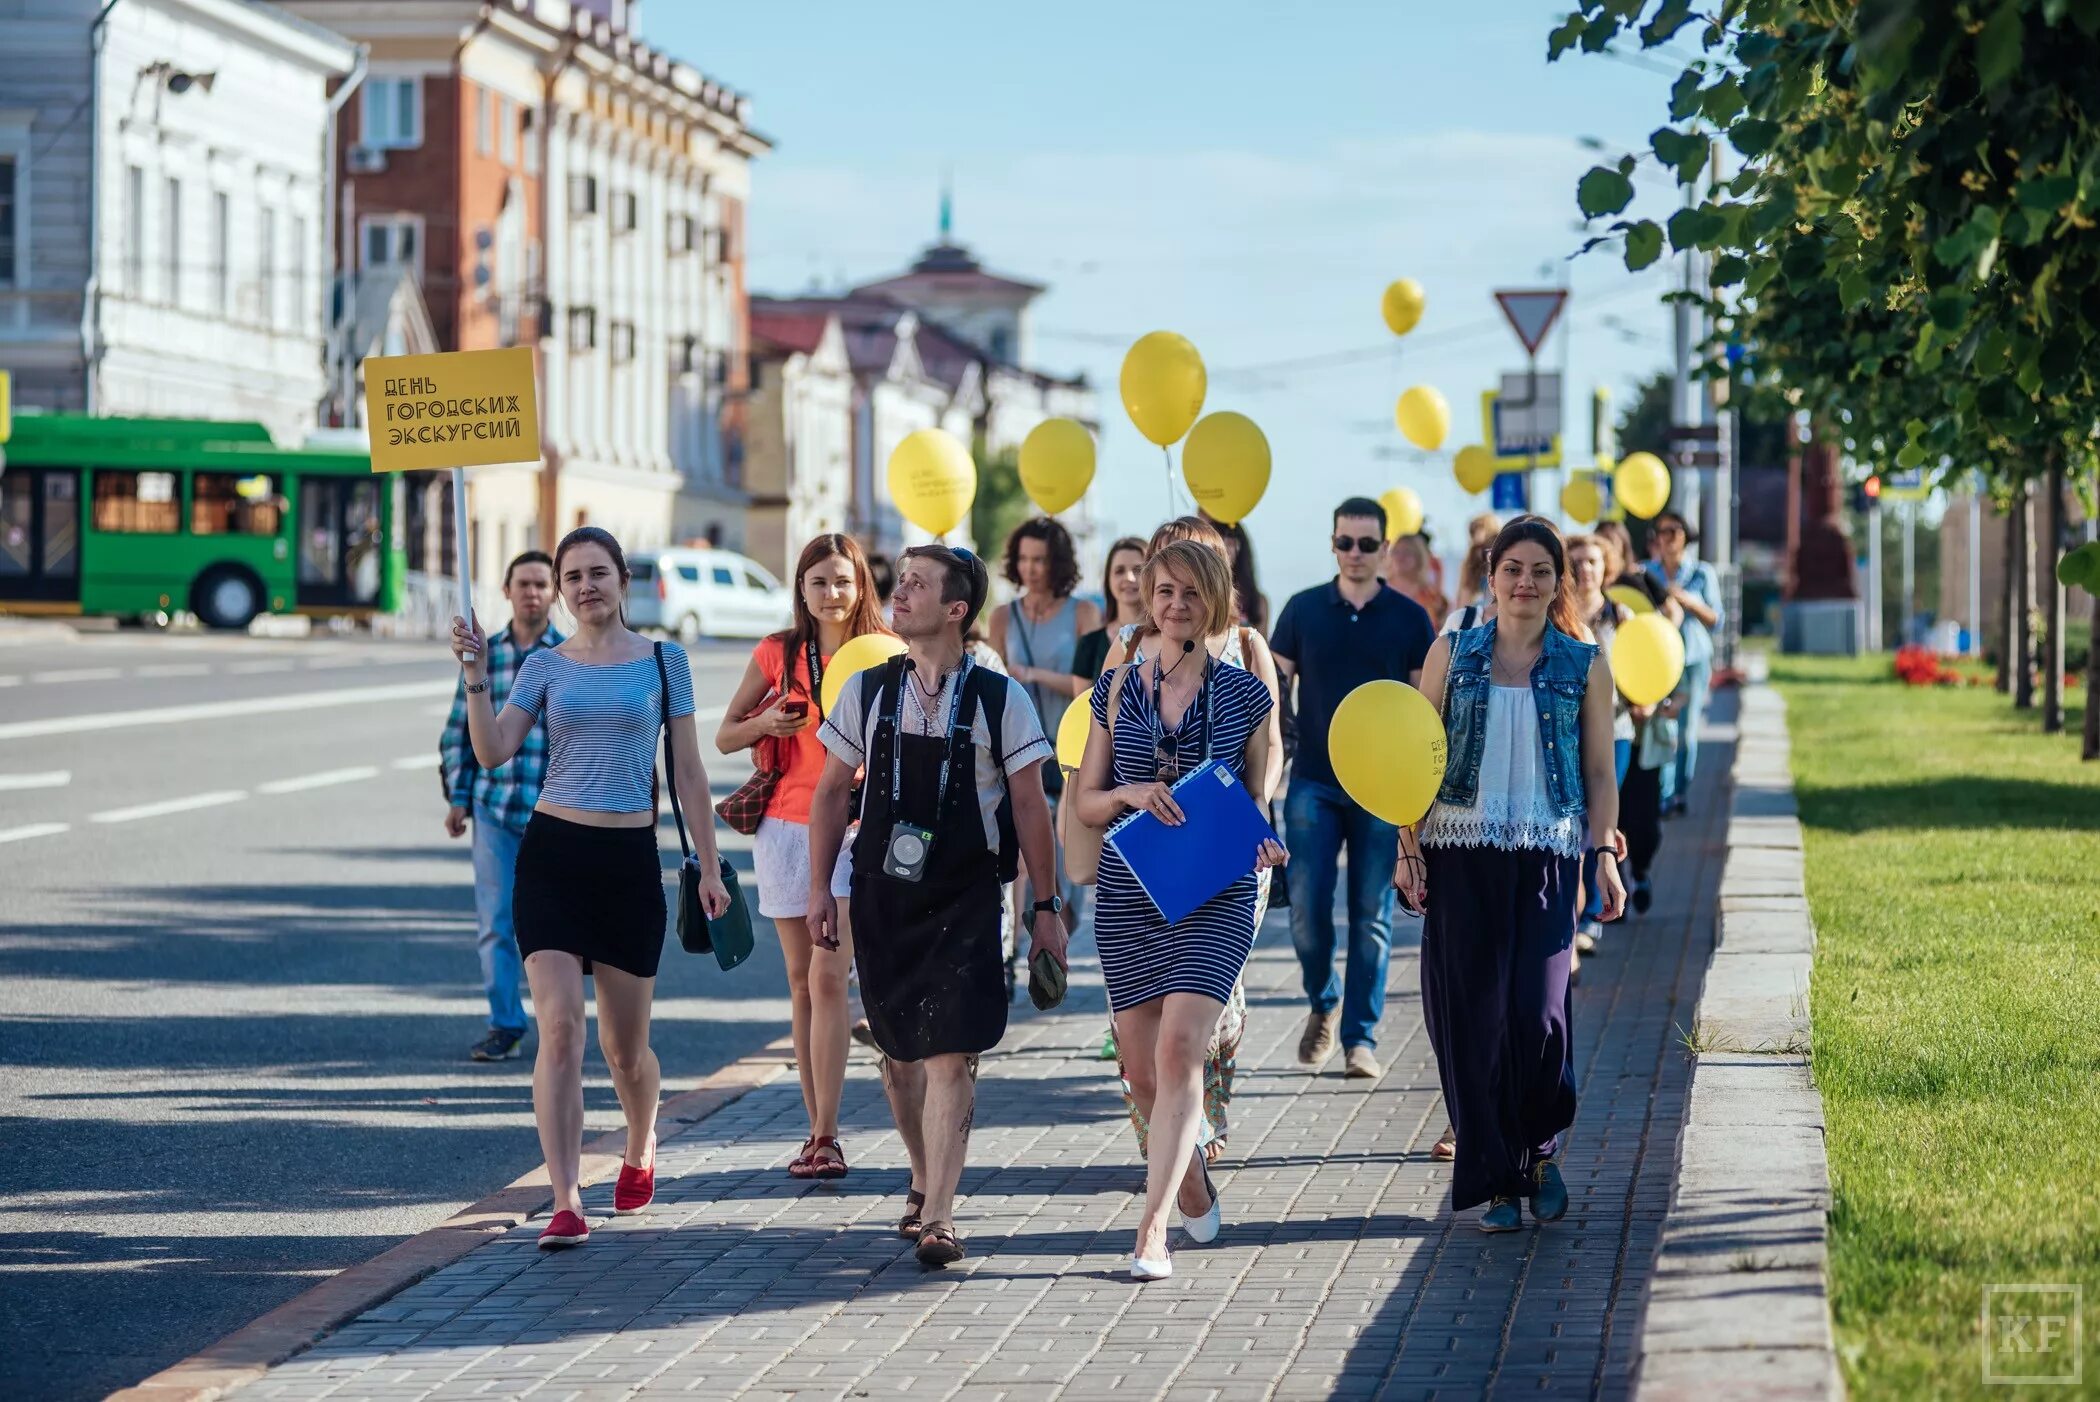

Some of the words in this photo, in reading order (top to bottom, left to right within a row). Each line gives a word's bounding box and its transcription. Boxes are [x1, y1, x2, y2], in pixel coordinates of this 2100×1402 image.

[385, 377, 436, 397] ДЕНЬ
[386, 396, 520, 421] ГОРОДСКИХ
[388, 418, 520, 445] ЭКСКУРСИЙ
[811, 656, 820, 685] DIGITAL
